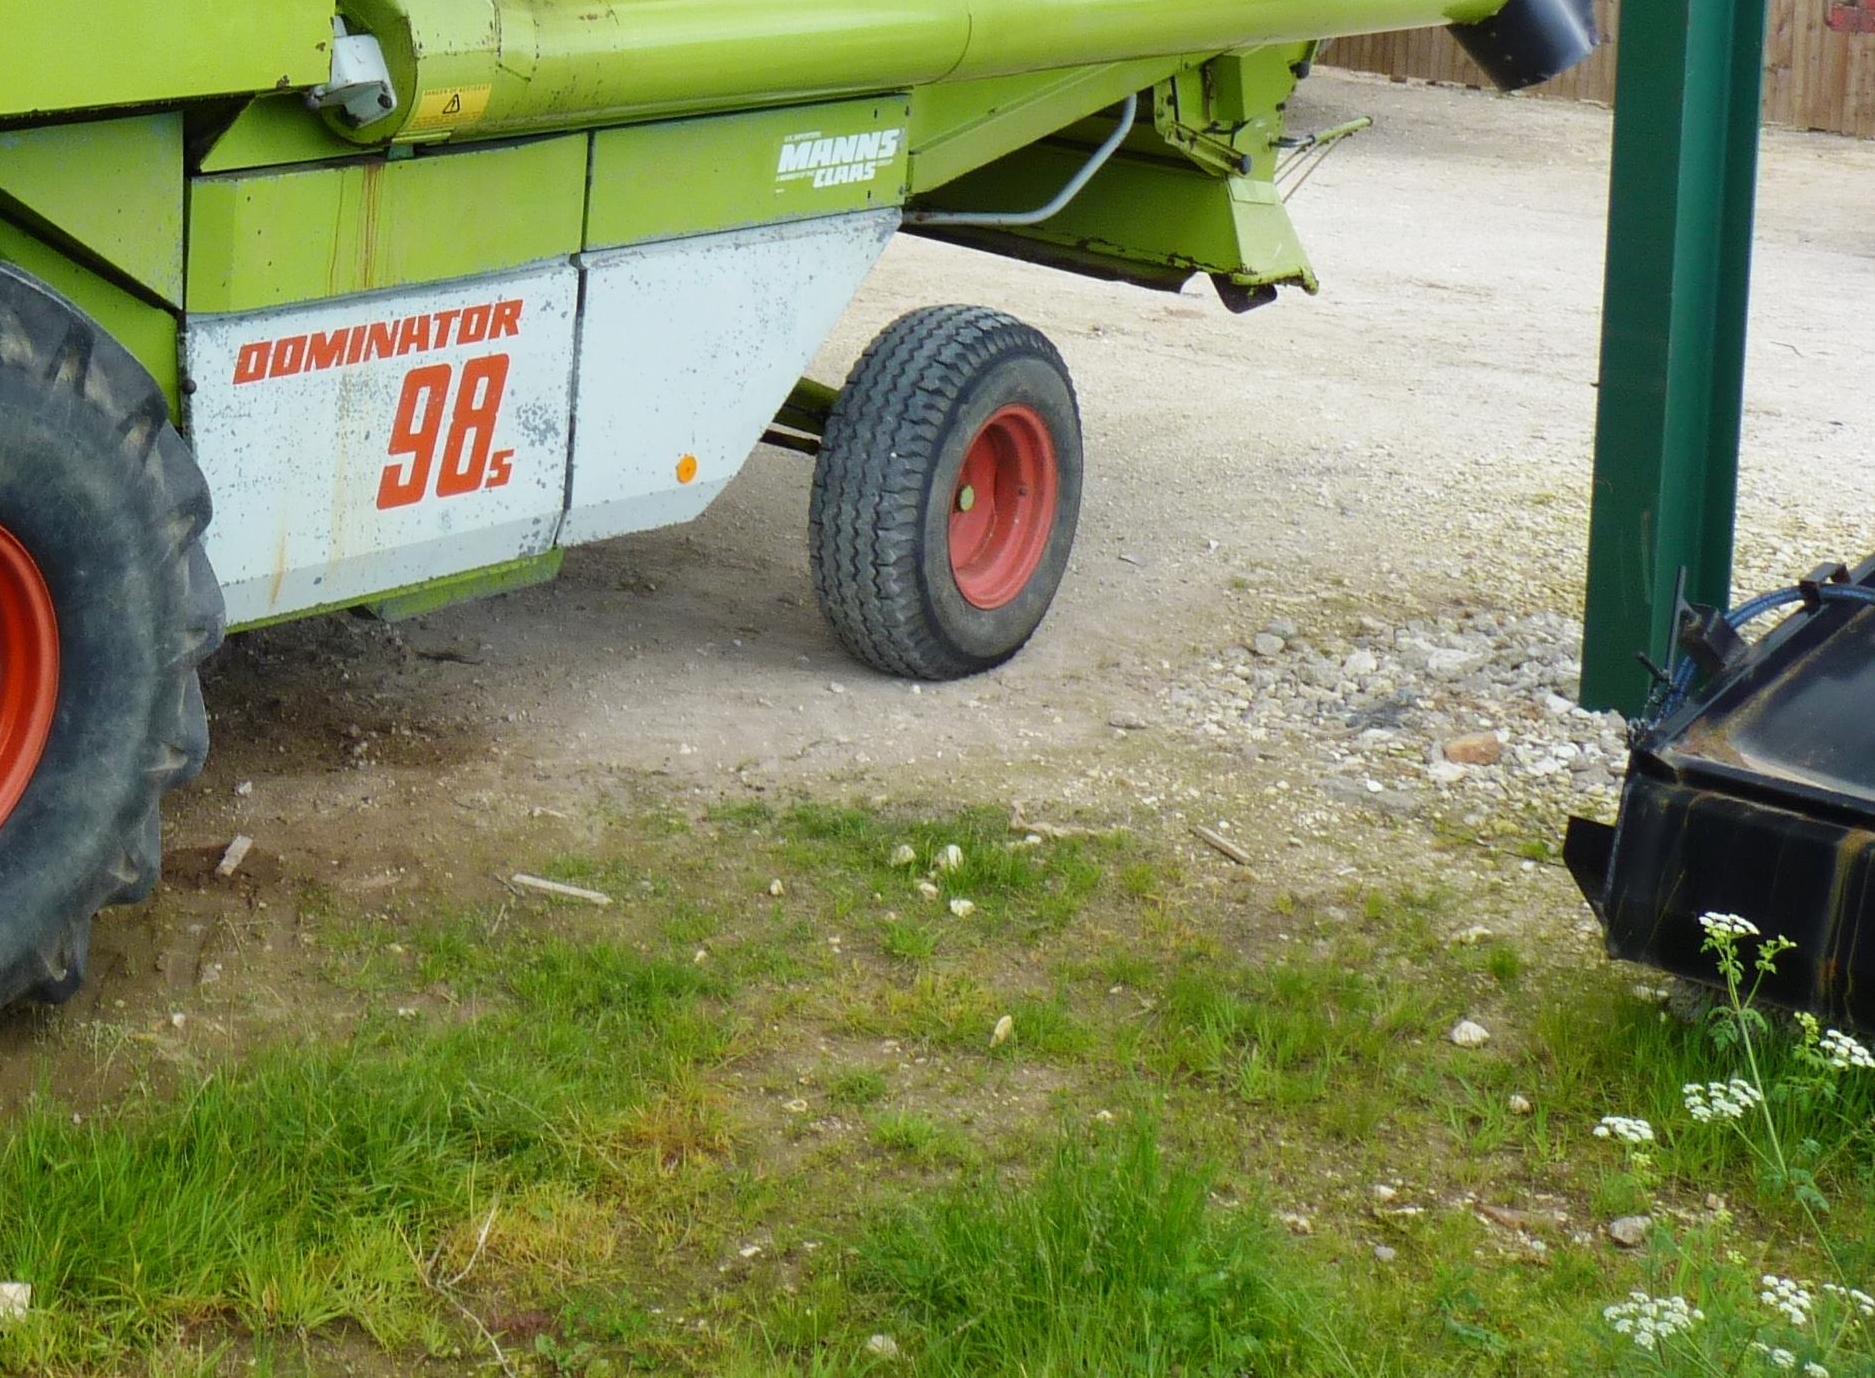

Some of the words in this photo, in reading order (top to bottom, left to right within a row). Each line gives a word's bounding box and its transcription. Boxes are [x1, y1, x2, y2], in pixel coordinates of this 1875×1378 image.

[777, 128, 900, 174] MANNS
[813, 161, 876, 189] CLAAS
[233, 299, 523, 385] DOMINATOR
